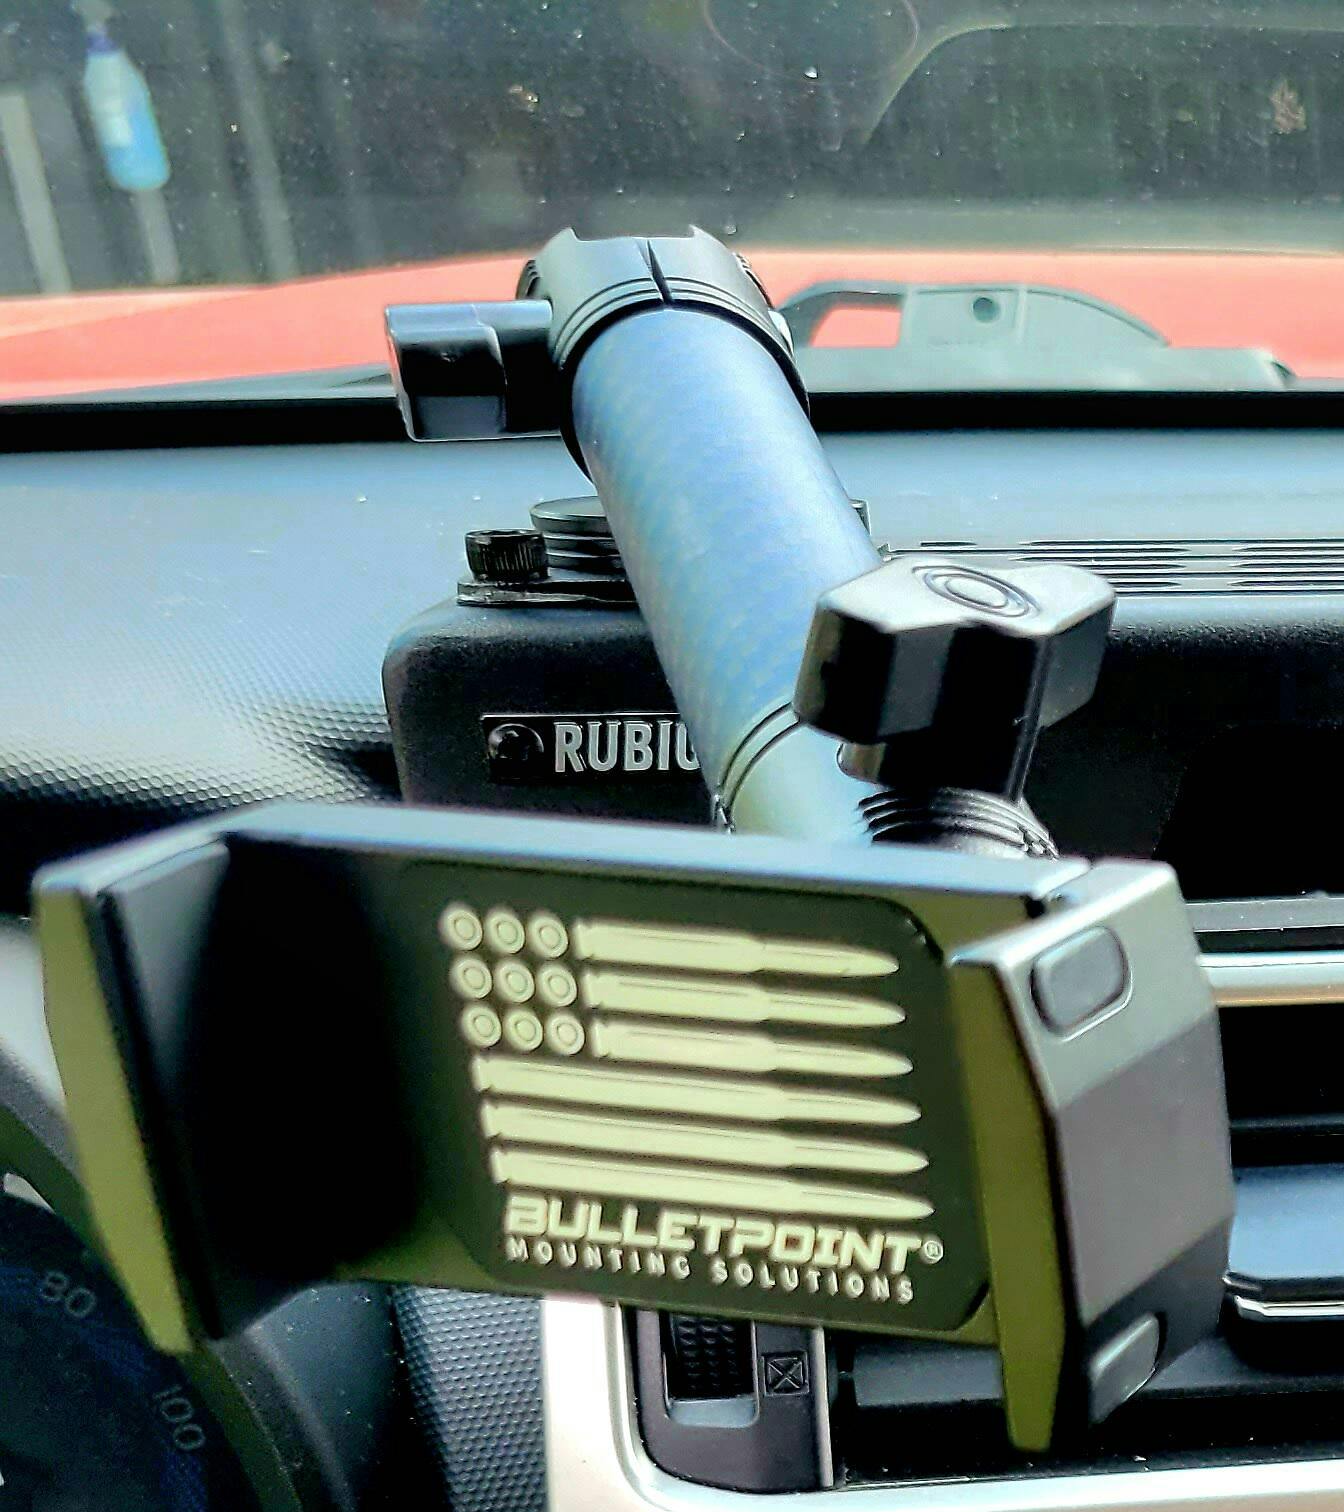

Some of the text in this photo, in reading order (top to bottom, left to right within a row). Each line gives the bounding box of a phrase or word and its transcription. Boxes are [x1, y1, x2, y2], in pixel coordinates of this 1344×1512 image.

[39, 1269, 97, 1320] 80
[506, 1235, 916, 1304] MOUNTING SOLUTIONS
[152, 1383, 206, 1452] 100
